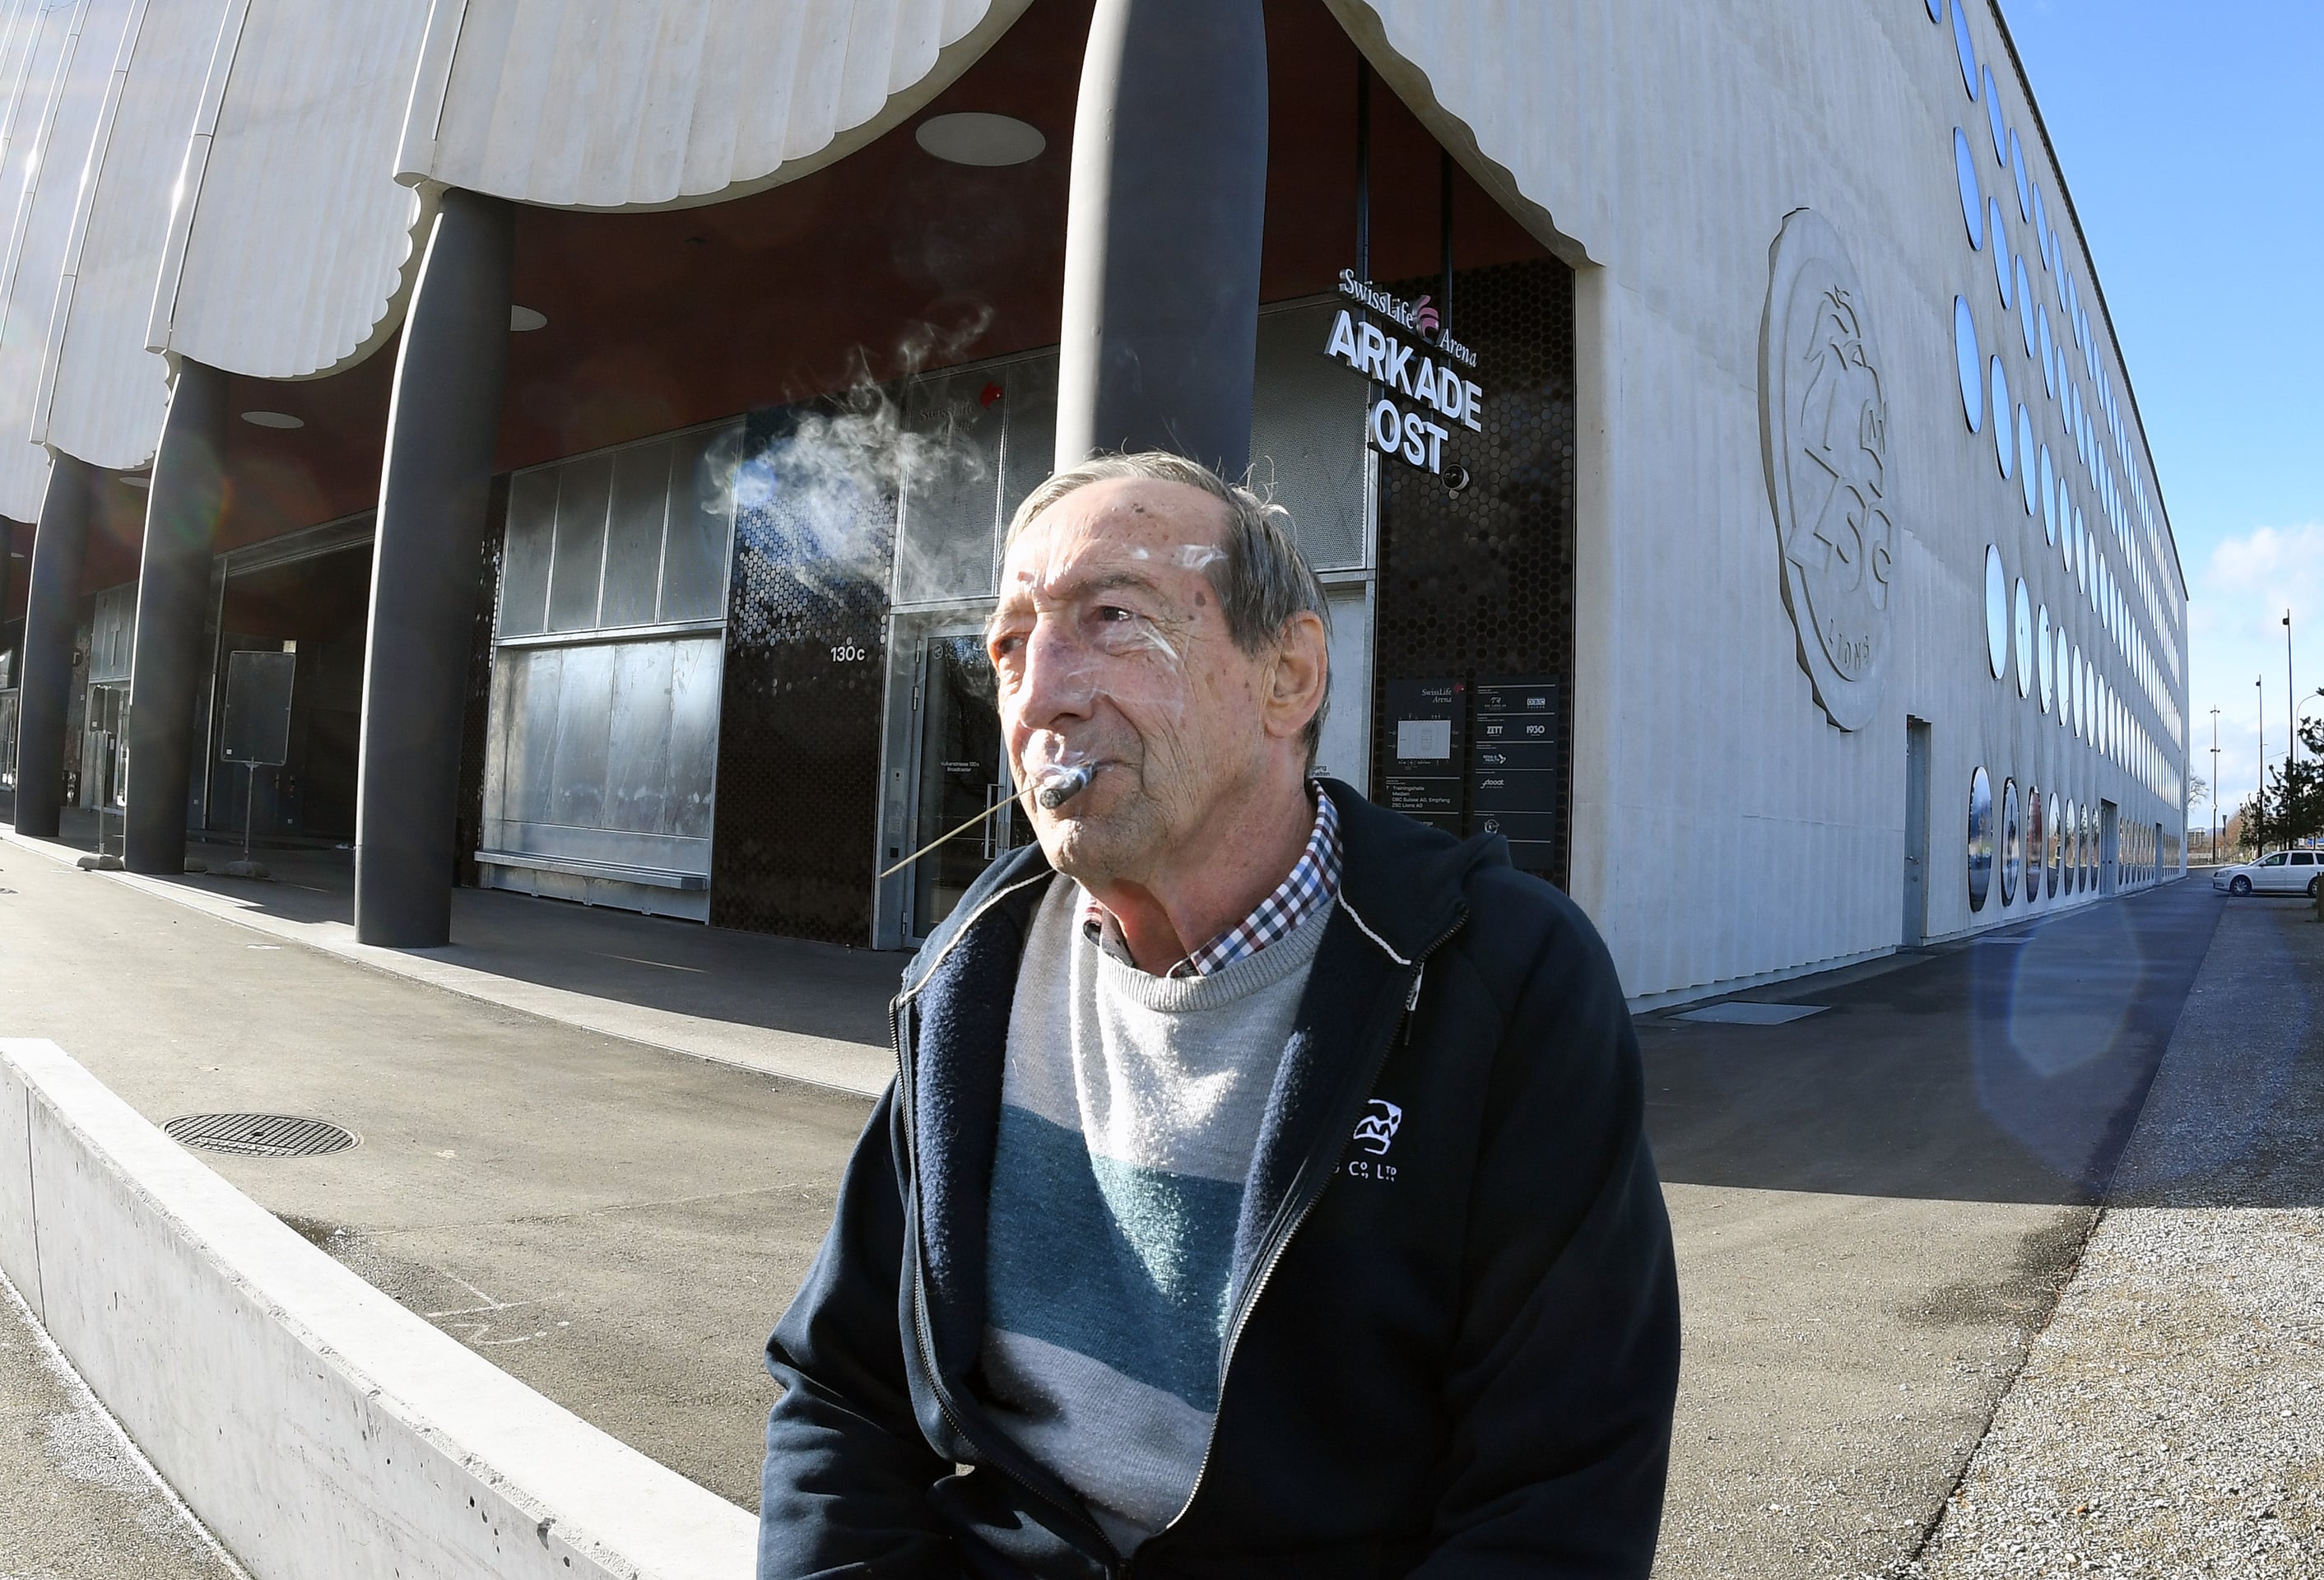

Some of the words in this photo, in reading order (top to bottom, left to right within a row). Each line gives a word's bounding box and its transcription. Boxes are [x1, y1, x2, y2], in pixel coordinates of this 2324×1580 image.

[1339, 268, 1414, 329] SwissLife
[1439, 328, 1477, 368] Arena
[1324, 309, 1482, 433] ARKADE
[1370, 399, 1448, 475] OST
[1829, 618, 1870, 670] LIONS
[1421, 687, 1452, 696] SwissLife
[1486, 726, 1504, 734] ZETT
[1526, 725, 1545, 734] 1930
